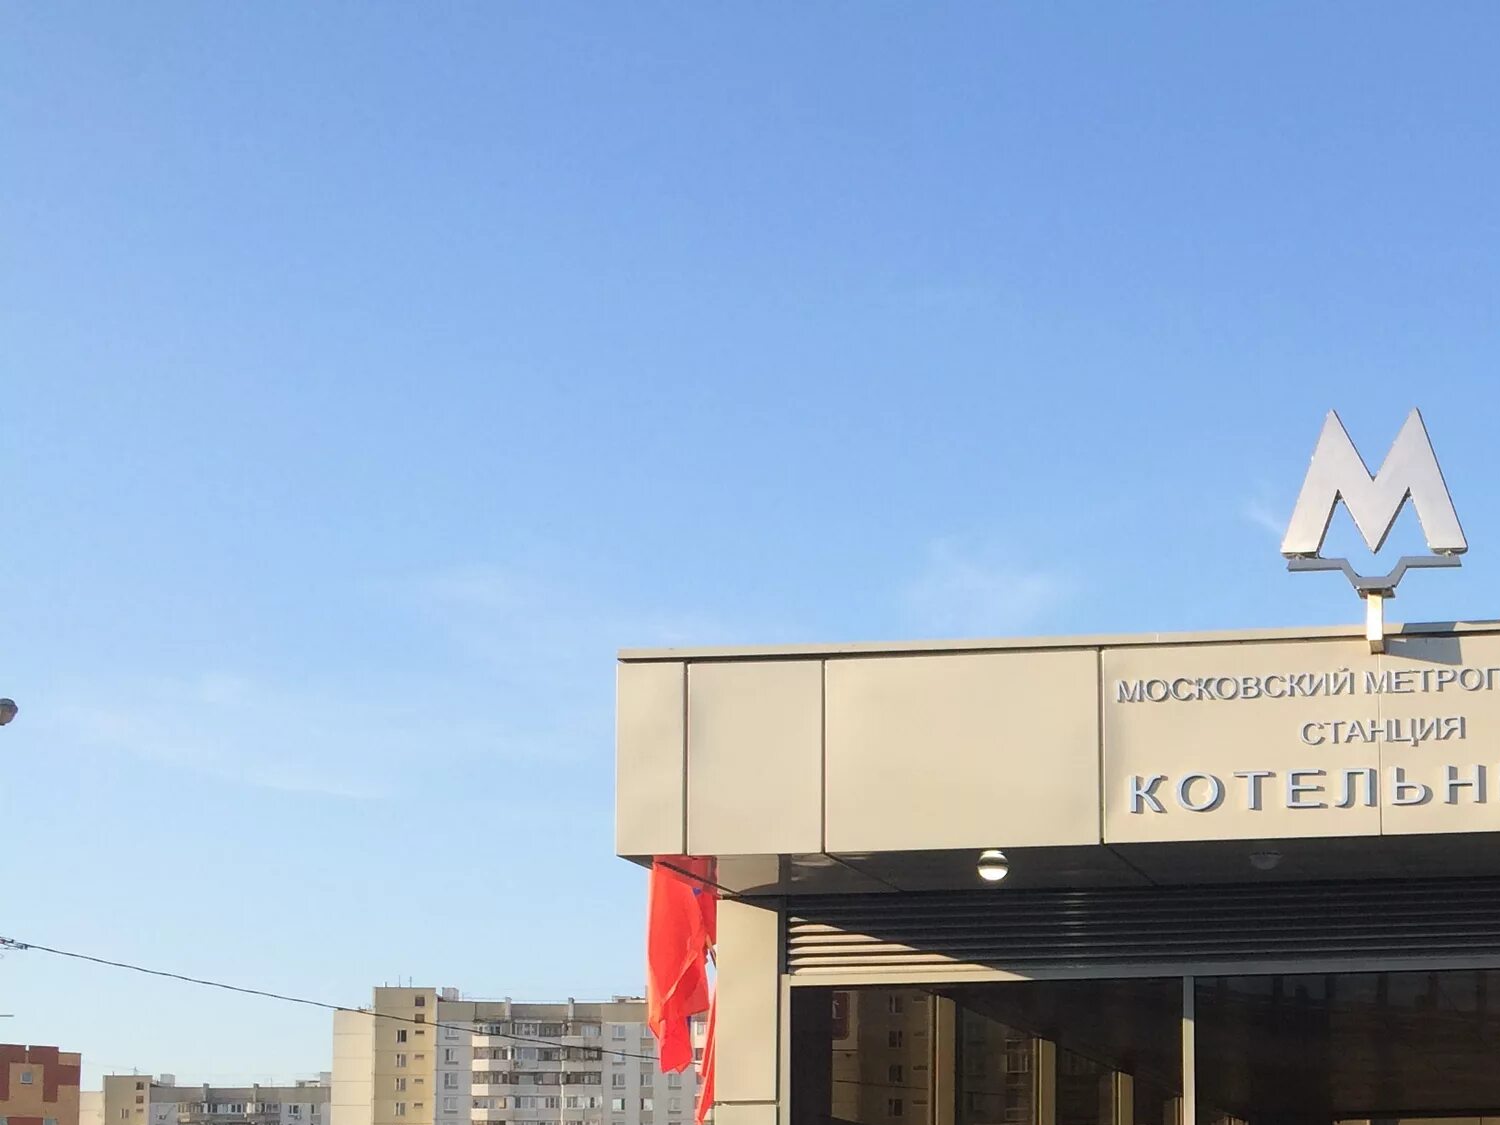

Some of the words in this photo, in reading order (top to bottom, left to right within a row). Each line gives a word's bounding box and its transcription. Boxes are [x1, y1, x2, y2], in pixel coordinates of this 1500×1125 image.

[1281, 407, 1468, 558] М
[1116, 668, 1355, 703] МОСКОВСКИЙ
[1300, 716, 1467, 747] СТАНЦИЯ
